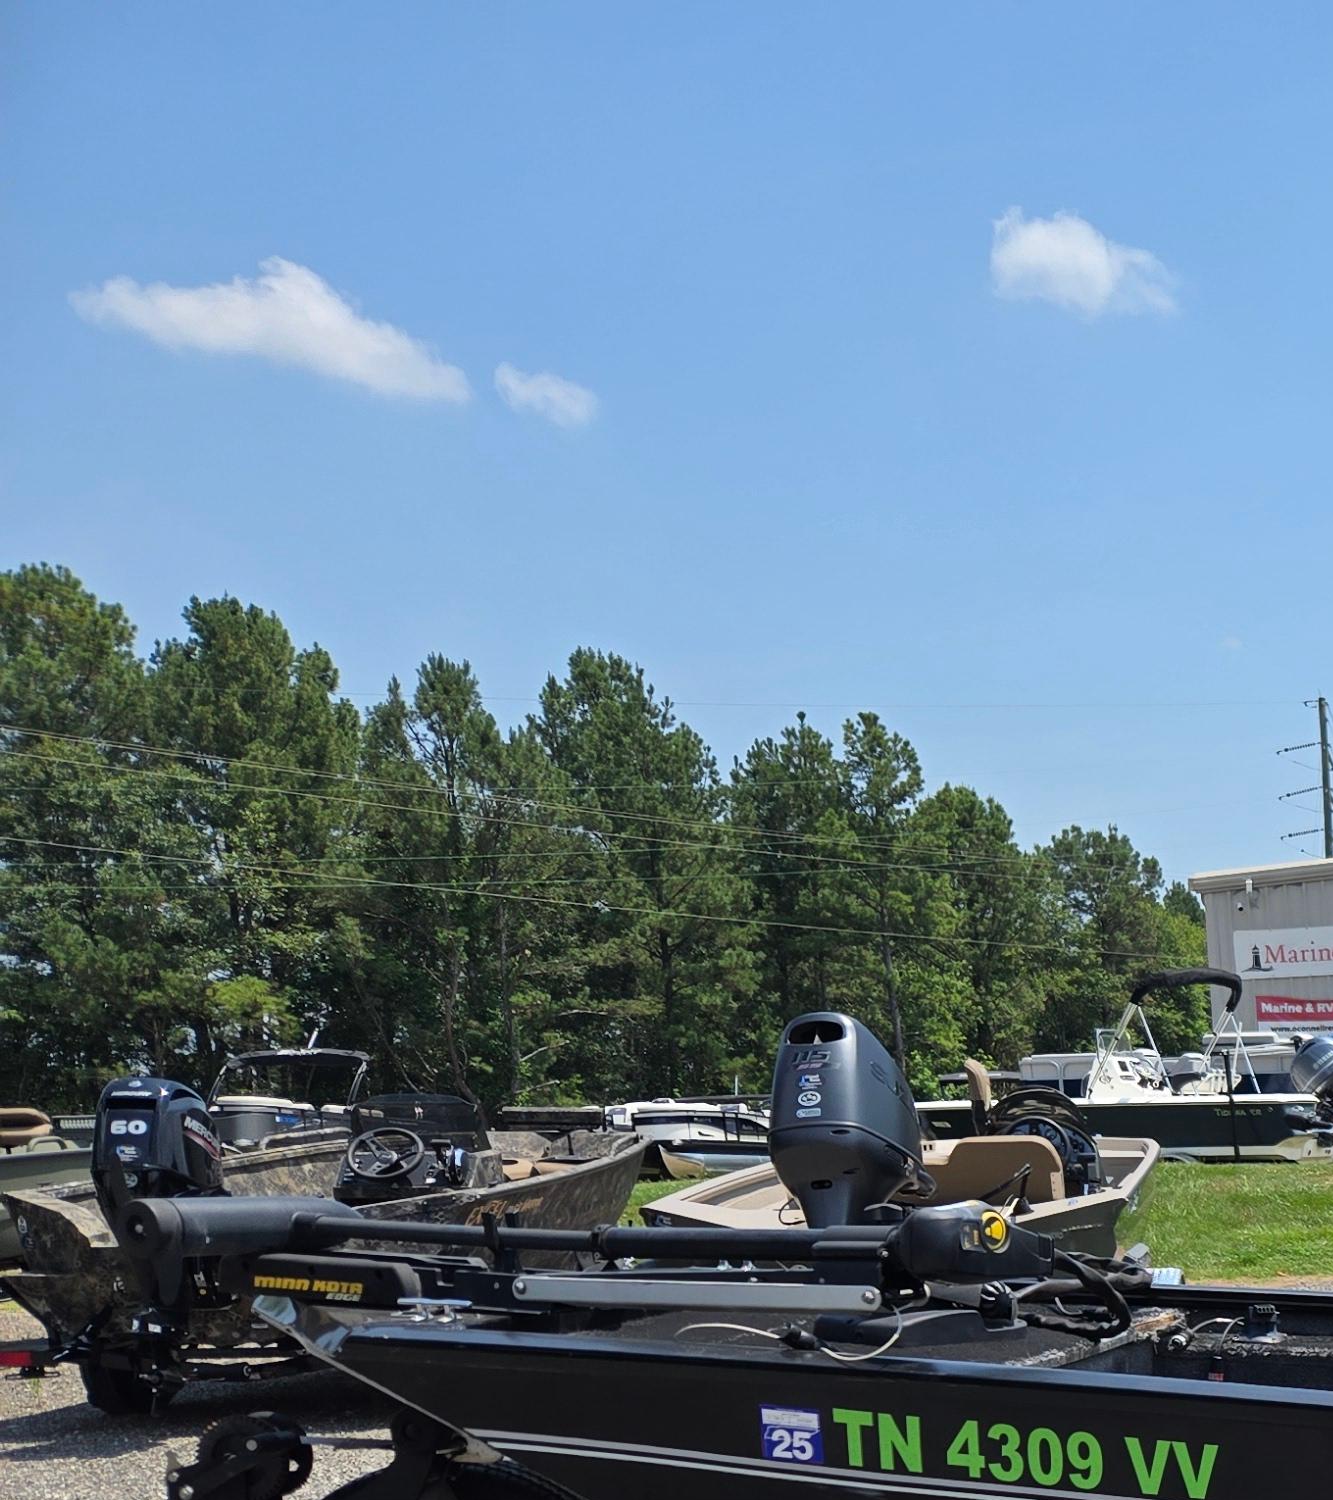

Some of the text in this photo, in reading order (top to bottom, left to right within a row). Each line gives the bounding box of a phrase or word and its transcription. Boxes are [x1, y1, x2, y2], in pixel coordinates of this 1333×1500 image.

[1261, 1002, 1302, 1014] Marine
[1305, 1003, 1314, 1013] &
[1317, 1003, 1333, 1012] RV
[110, 1120, 148, 1135] 60
[254, 1275, 363, 1294] MINN KOTA
[325, 1292, 361, 1302] EDGE
[771, 1428, 814, 1461] 25
[832, 1407, 1219, 1500] TN 4309 VV
